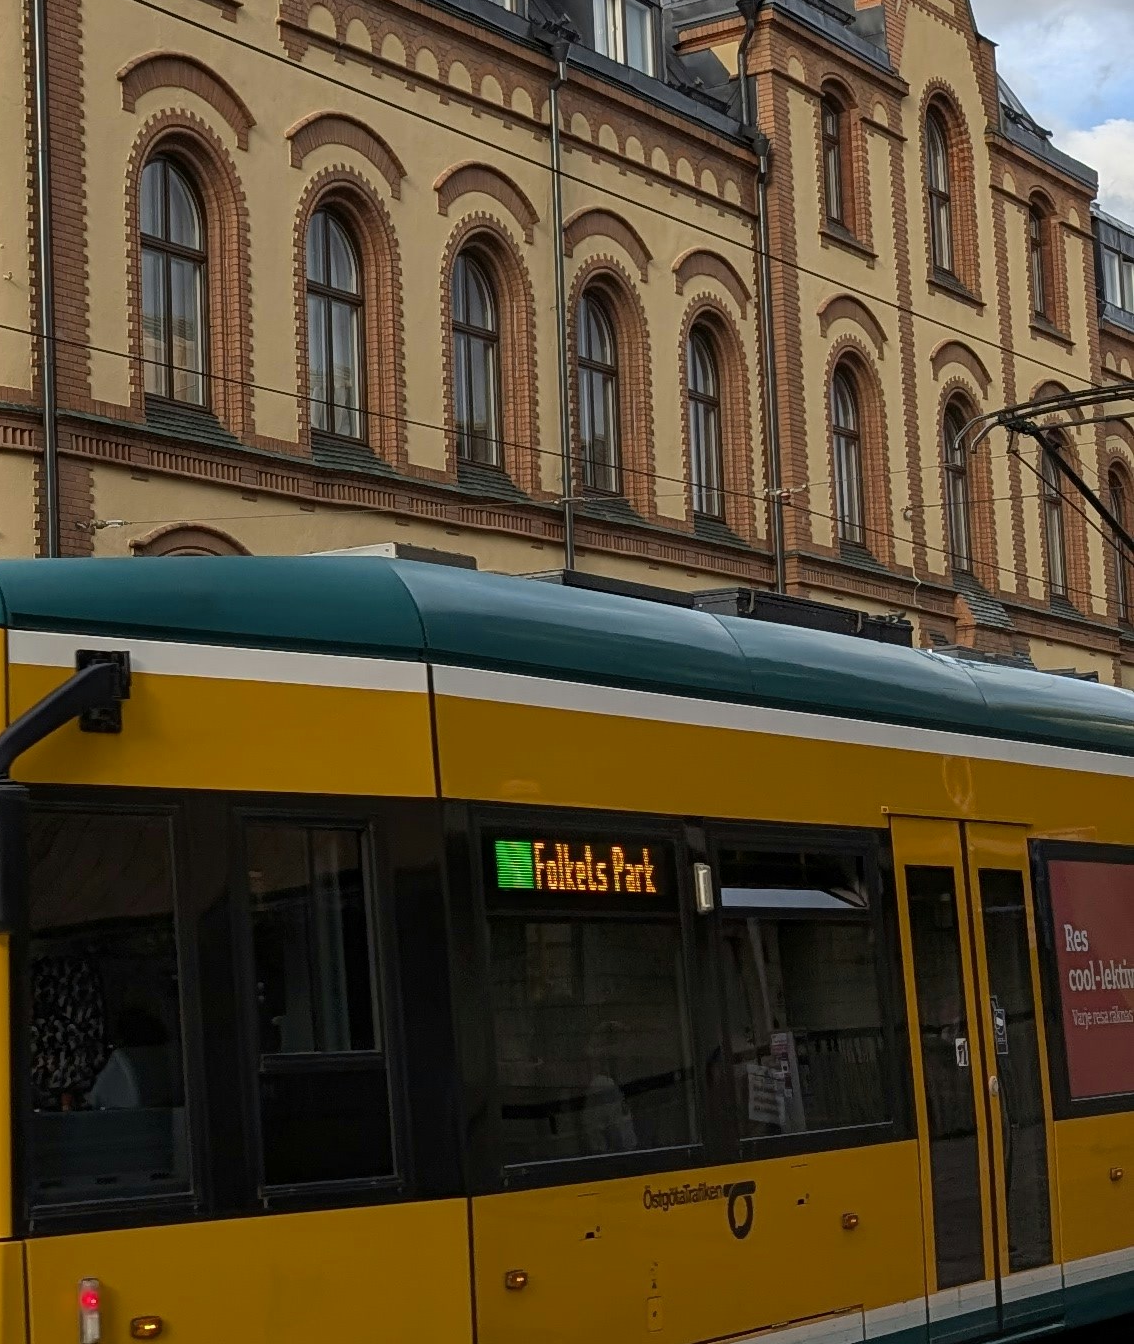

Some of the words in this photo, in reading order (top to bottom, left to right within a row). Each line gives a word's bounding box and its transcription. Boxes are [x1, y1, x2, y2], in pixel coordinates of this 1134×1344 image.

[533, 842, 608, 892] Folkets
[611, 846, 657, 893] Park
[1063, 923, 1089, 952] Res
[1072, 1007, 1092, 1030] Varje
[1093, 1011, 1109, 1024] resa
[643, 1183, 723, 1211] ÖstgötaTrafiken
